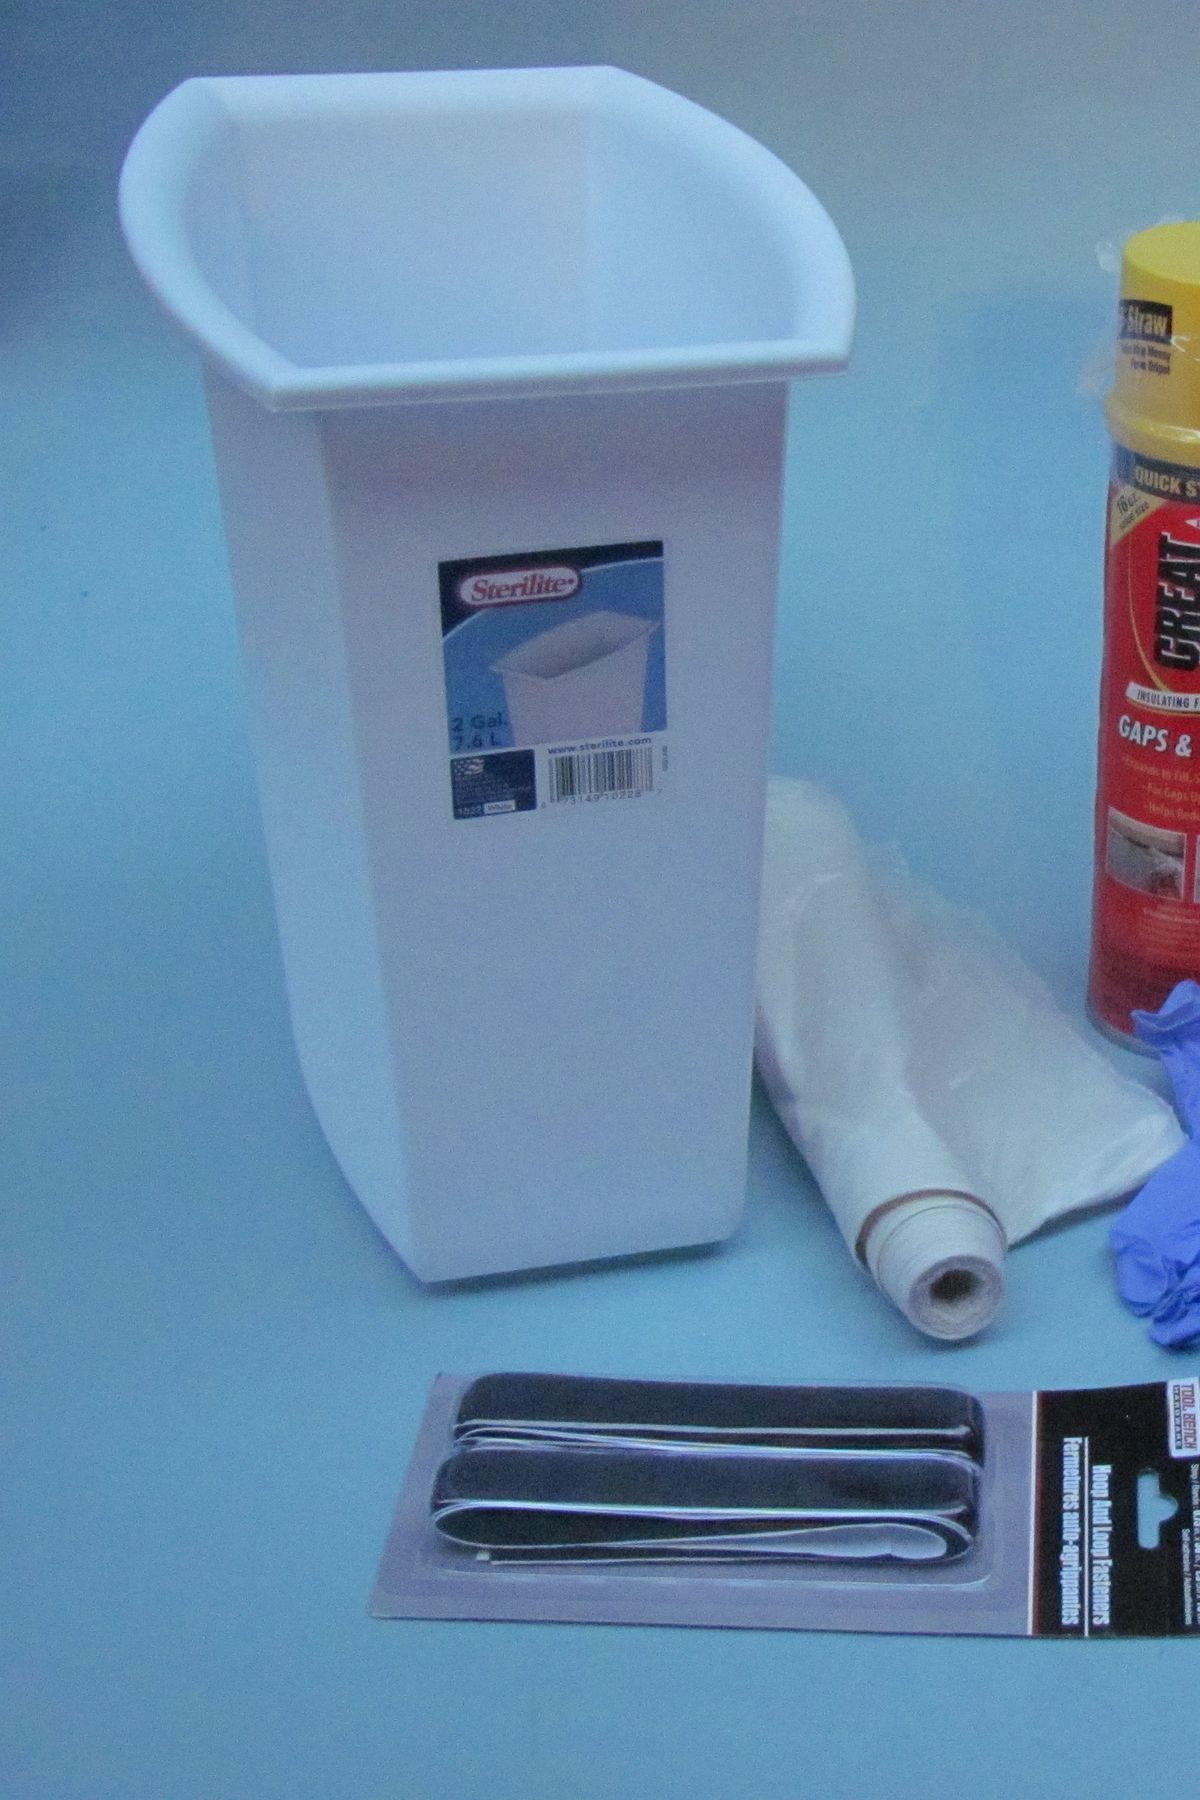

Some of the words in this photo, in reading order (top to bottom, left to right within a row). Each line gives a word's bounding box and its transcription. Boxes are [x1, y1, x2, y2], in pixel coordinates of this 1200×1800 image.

[1136, 467, 1181, 495] QUICK
[471, 573, 569, 601] Sterilite
[1137, 689, 1190, 709] INSULATING
[453, 717, 464, 731] 2
[1118, 714, 1168, 752] GAPS
[1175, 734, 1192, 758] &
[547, 736, 651, 755] www.sterilite.com
[1181, 1383, 1196, 1412] TOOL
[1173, 1385, 1182, 1448] HARDWARE
[1063, 1437, 1082, 1510] Fermetures
[1092, 1500, 1112, 1524] And
[1091, 1527, 1112, 1557] Loop
[1093, 1559, 1113, 1625] Fasteners
